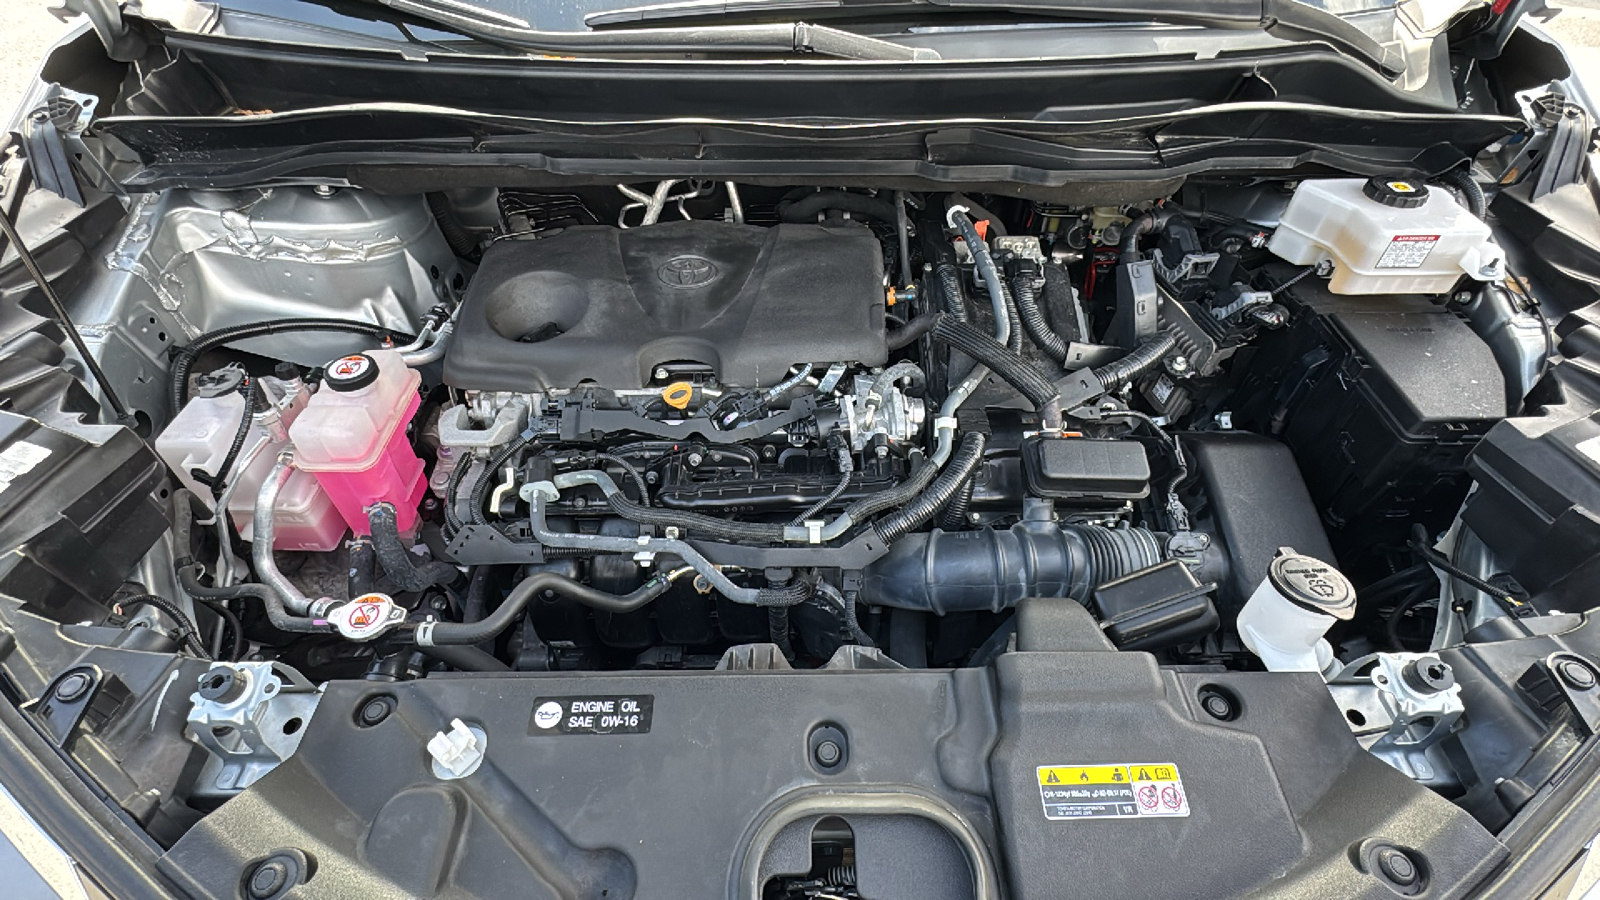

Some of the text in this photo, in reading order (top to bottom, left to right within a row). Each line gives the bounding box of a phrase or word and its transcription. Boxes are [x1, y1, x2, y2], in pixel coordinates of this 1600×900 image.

[571, 700, 641, 713] ENGINE OIL
[568, 715, 639, 728] SAE 0W-16
